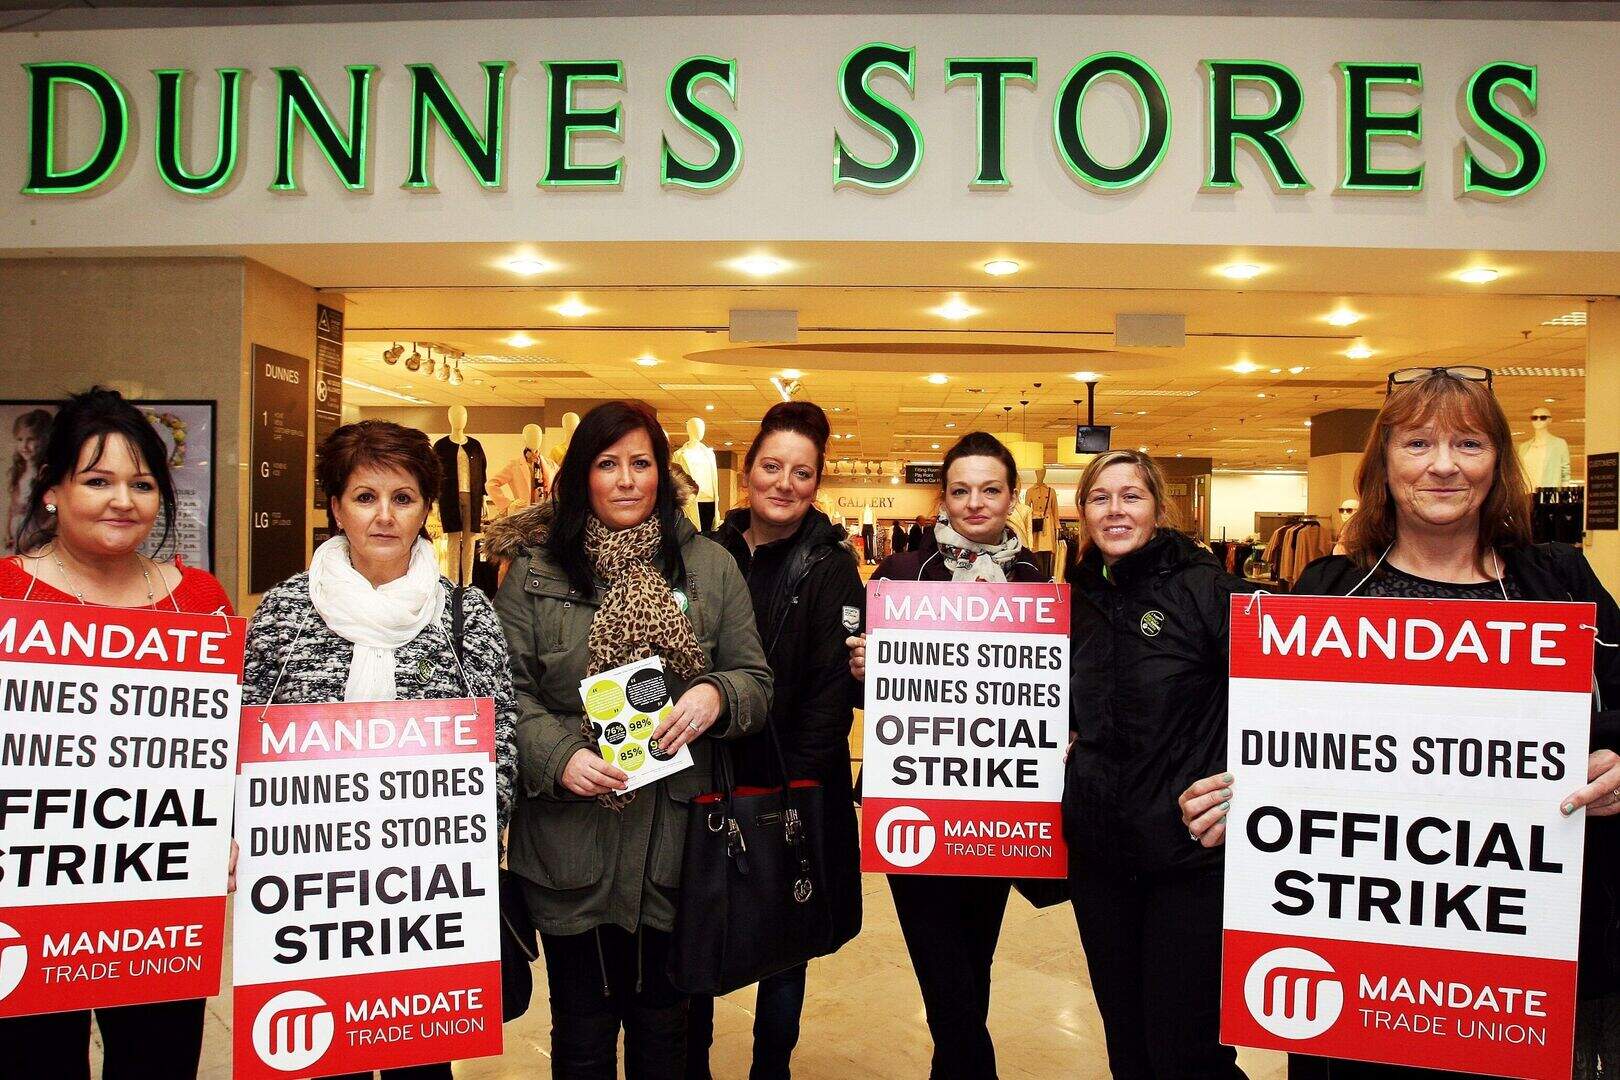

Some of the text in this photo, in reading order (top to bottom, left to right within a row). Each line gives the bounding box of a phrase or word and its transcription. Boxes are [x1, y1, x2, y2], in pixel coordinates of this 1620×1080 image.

[21, 42, 1547, 198] DUNNES STORES
[265, 363, 300, 384] DUNNES
[262, 410, 268, 427] 1
[261, 461, 270, 478] G
[255, 512, 269, 529] LG
[884, 594, 1056, 624] MANDATE
[878, 640, 1062, 670] DUNNES STORES
[1262, 614, 1567, 666] MANDATE
[0, 678, 230, 720] NNES STORES
[876, 677, 1060, 708] DUNNES STORES
[261, 714, 478, 755] MANDATE
[605, 725, 624, 737] 76%
[629, 718, 652, 732] 98%
[875, 715, 1058, 748] OFFICIAL
[108, 735, 228, 770] STORES
[620, 747, 643, 761] 85%
[1241, 728, 1566, 781] DUNNES STORES
[249, 766, 485, 808] DUNNES STORES
[891, 755, 1039, 789] STRIKE
[0, 787, 218, 830] FFICIAL
[250, 813, 487, 857] DUNNES STORES
[943, 819, 1052, 840] MANDATE
[1246, 805, 1564, 875] OFFICIAL
[0, 841, 190, 888] TRIKE
[944, 842, 1052, 858] TRADE UNION
[250, 861, 486, 915] OFFICIAL
[1271, 869, 1527, 935] STRIKE
[42, 924, 204, 958] MANDATE
[273, 911, 465, 965] STRIKE
[41, 954, 202, 984] TRADE UNION
[344, 987, 484, 1024] MANDATE
[1358, 973, 1548, 1017] MANDATE
[345, 1016, 485, 1047] TRADE UNION
[1358, 1008, 1547, 1047] TRADE UNION
